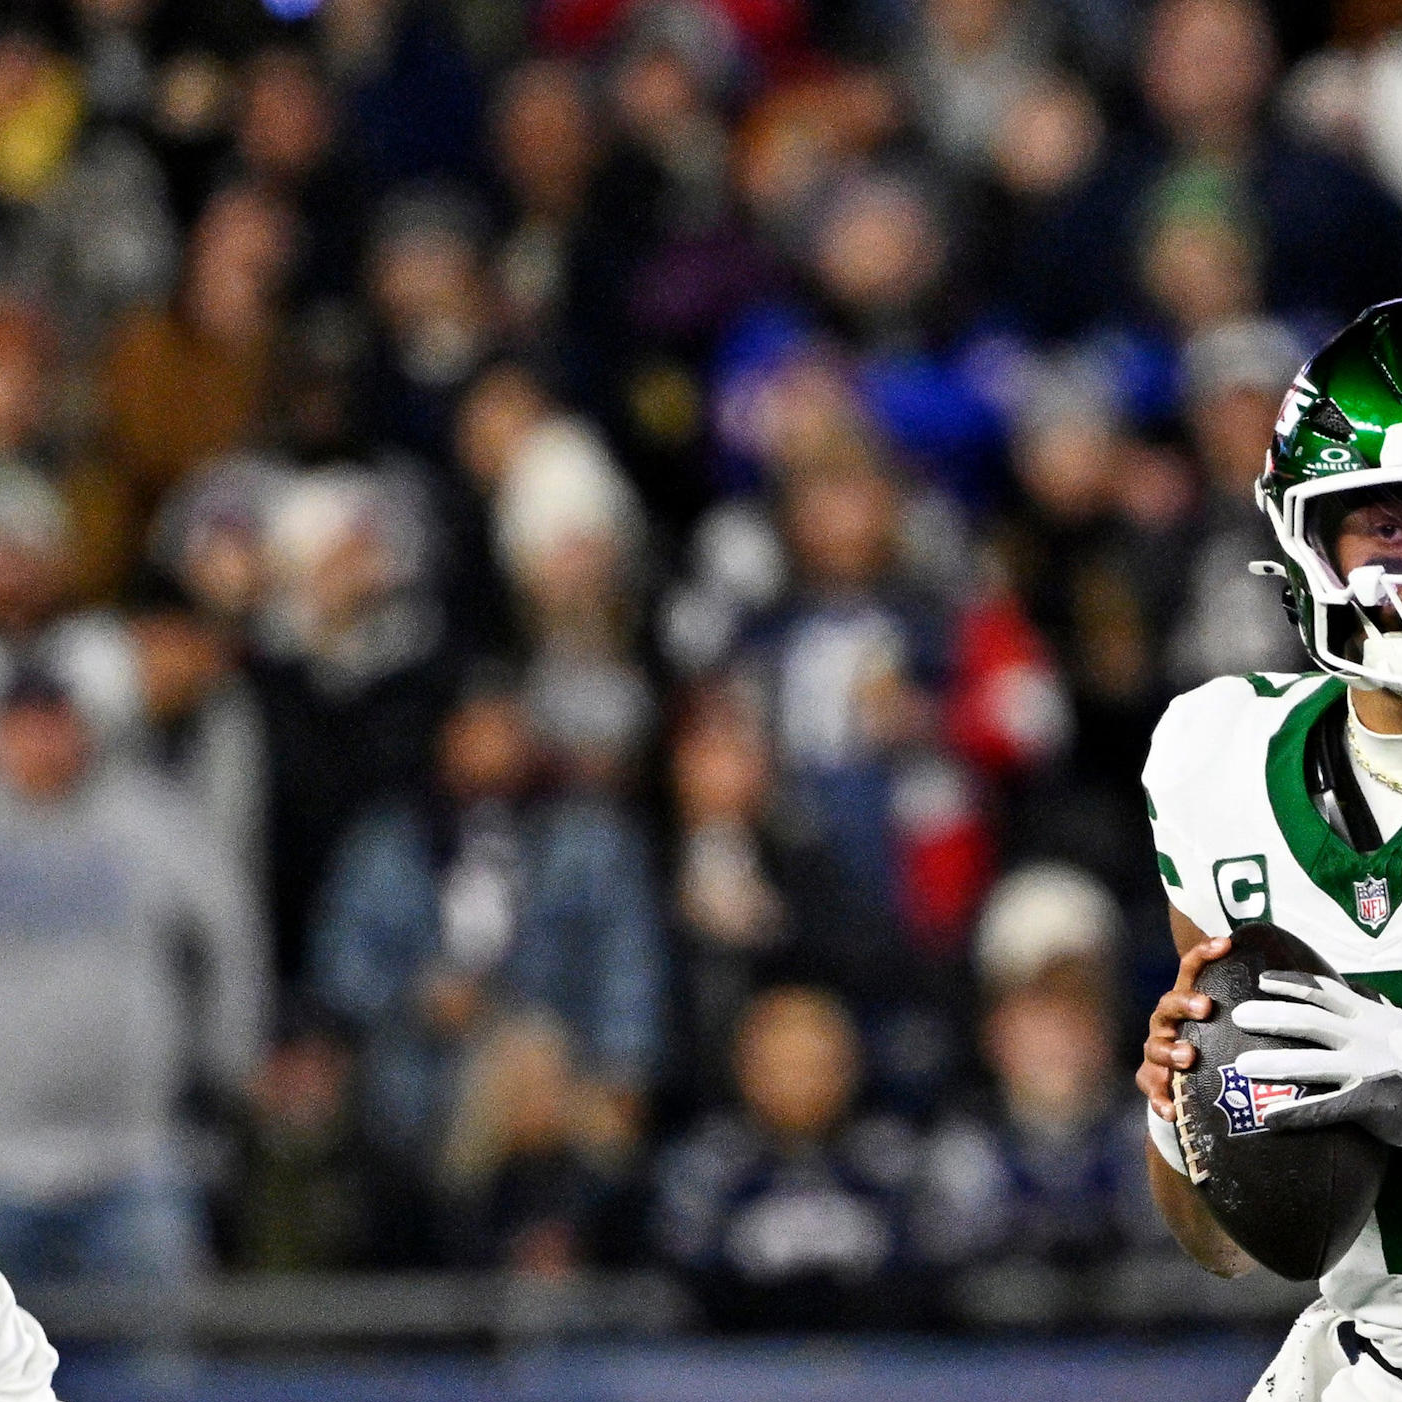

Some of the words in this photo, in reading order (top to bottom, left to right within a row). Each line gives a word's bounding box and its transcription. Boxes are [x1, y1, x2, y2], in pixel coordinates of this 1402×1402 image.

[1315, 462, 1359, 471] OAKLEY
[1217, 859, 1266, 920] C
[1360, 896, 1386, 919] NFL
